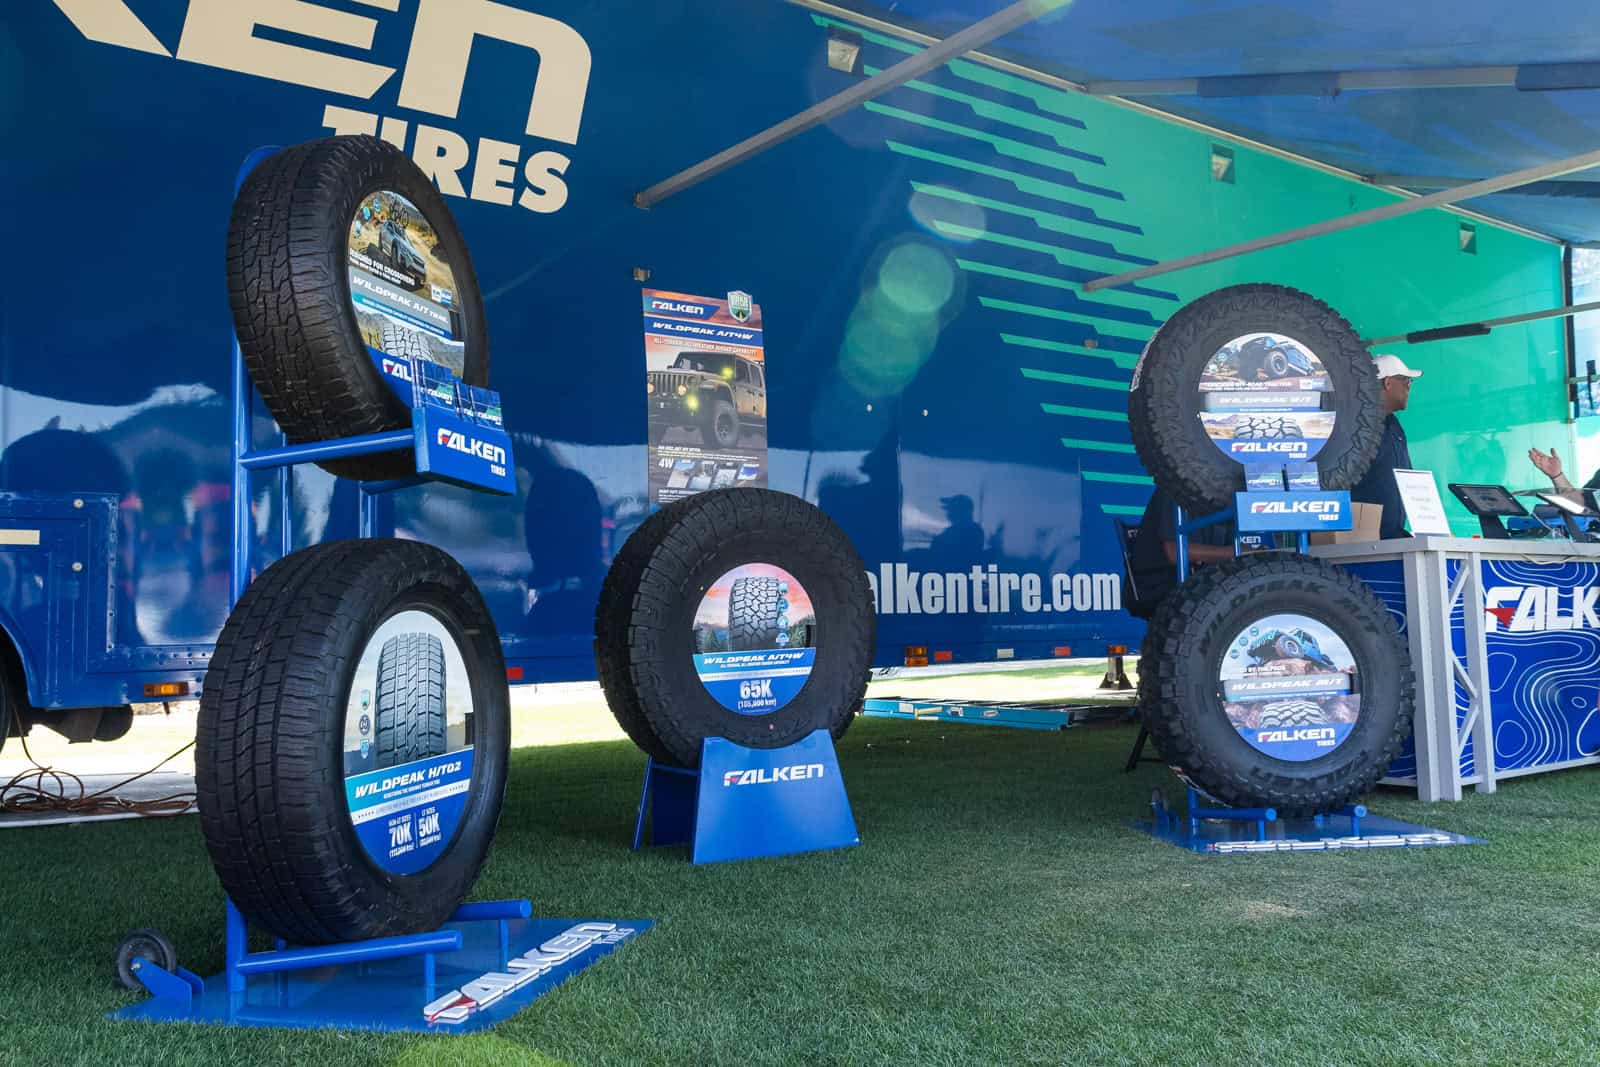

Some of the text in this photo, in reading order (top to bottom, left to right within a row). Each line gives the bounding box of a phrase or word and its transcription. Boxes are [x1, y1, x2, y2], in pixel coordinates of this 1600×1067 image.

[352, 276, 413, 308] WILDPEAK
[653, 322, 715, 336] WILDPEAK
[437, 427, 506, 465] FALKEN
[1232, 442, 1308, 453] FALKEN
[1251, 501, 1340, 513] FALKEN
[864, 562, 1121, 615] lkentire.com
[704, 654, 766, 665] WILDPEAK
[740, 679, 774, 700] 65K
[1258, 728, 1336, 742] FALKEN
[355, 769, 426, 799] WILDPEAK
[723, 763, 824, 787] FALKEN
[388, 822, 413, 847] 70K
[418, 813, 440, 837] 50K
